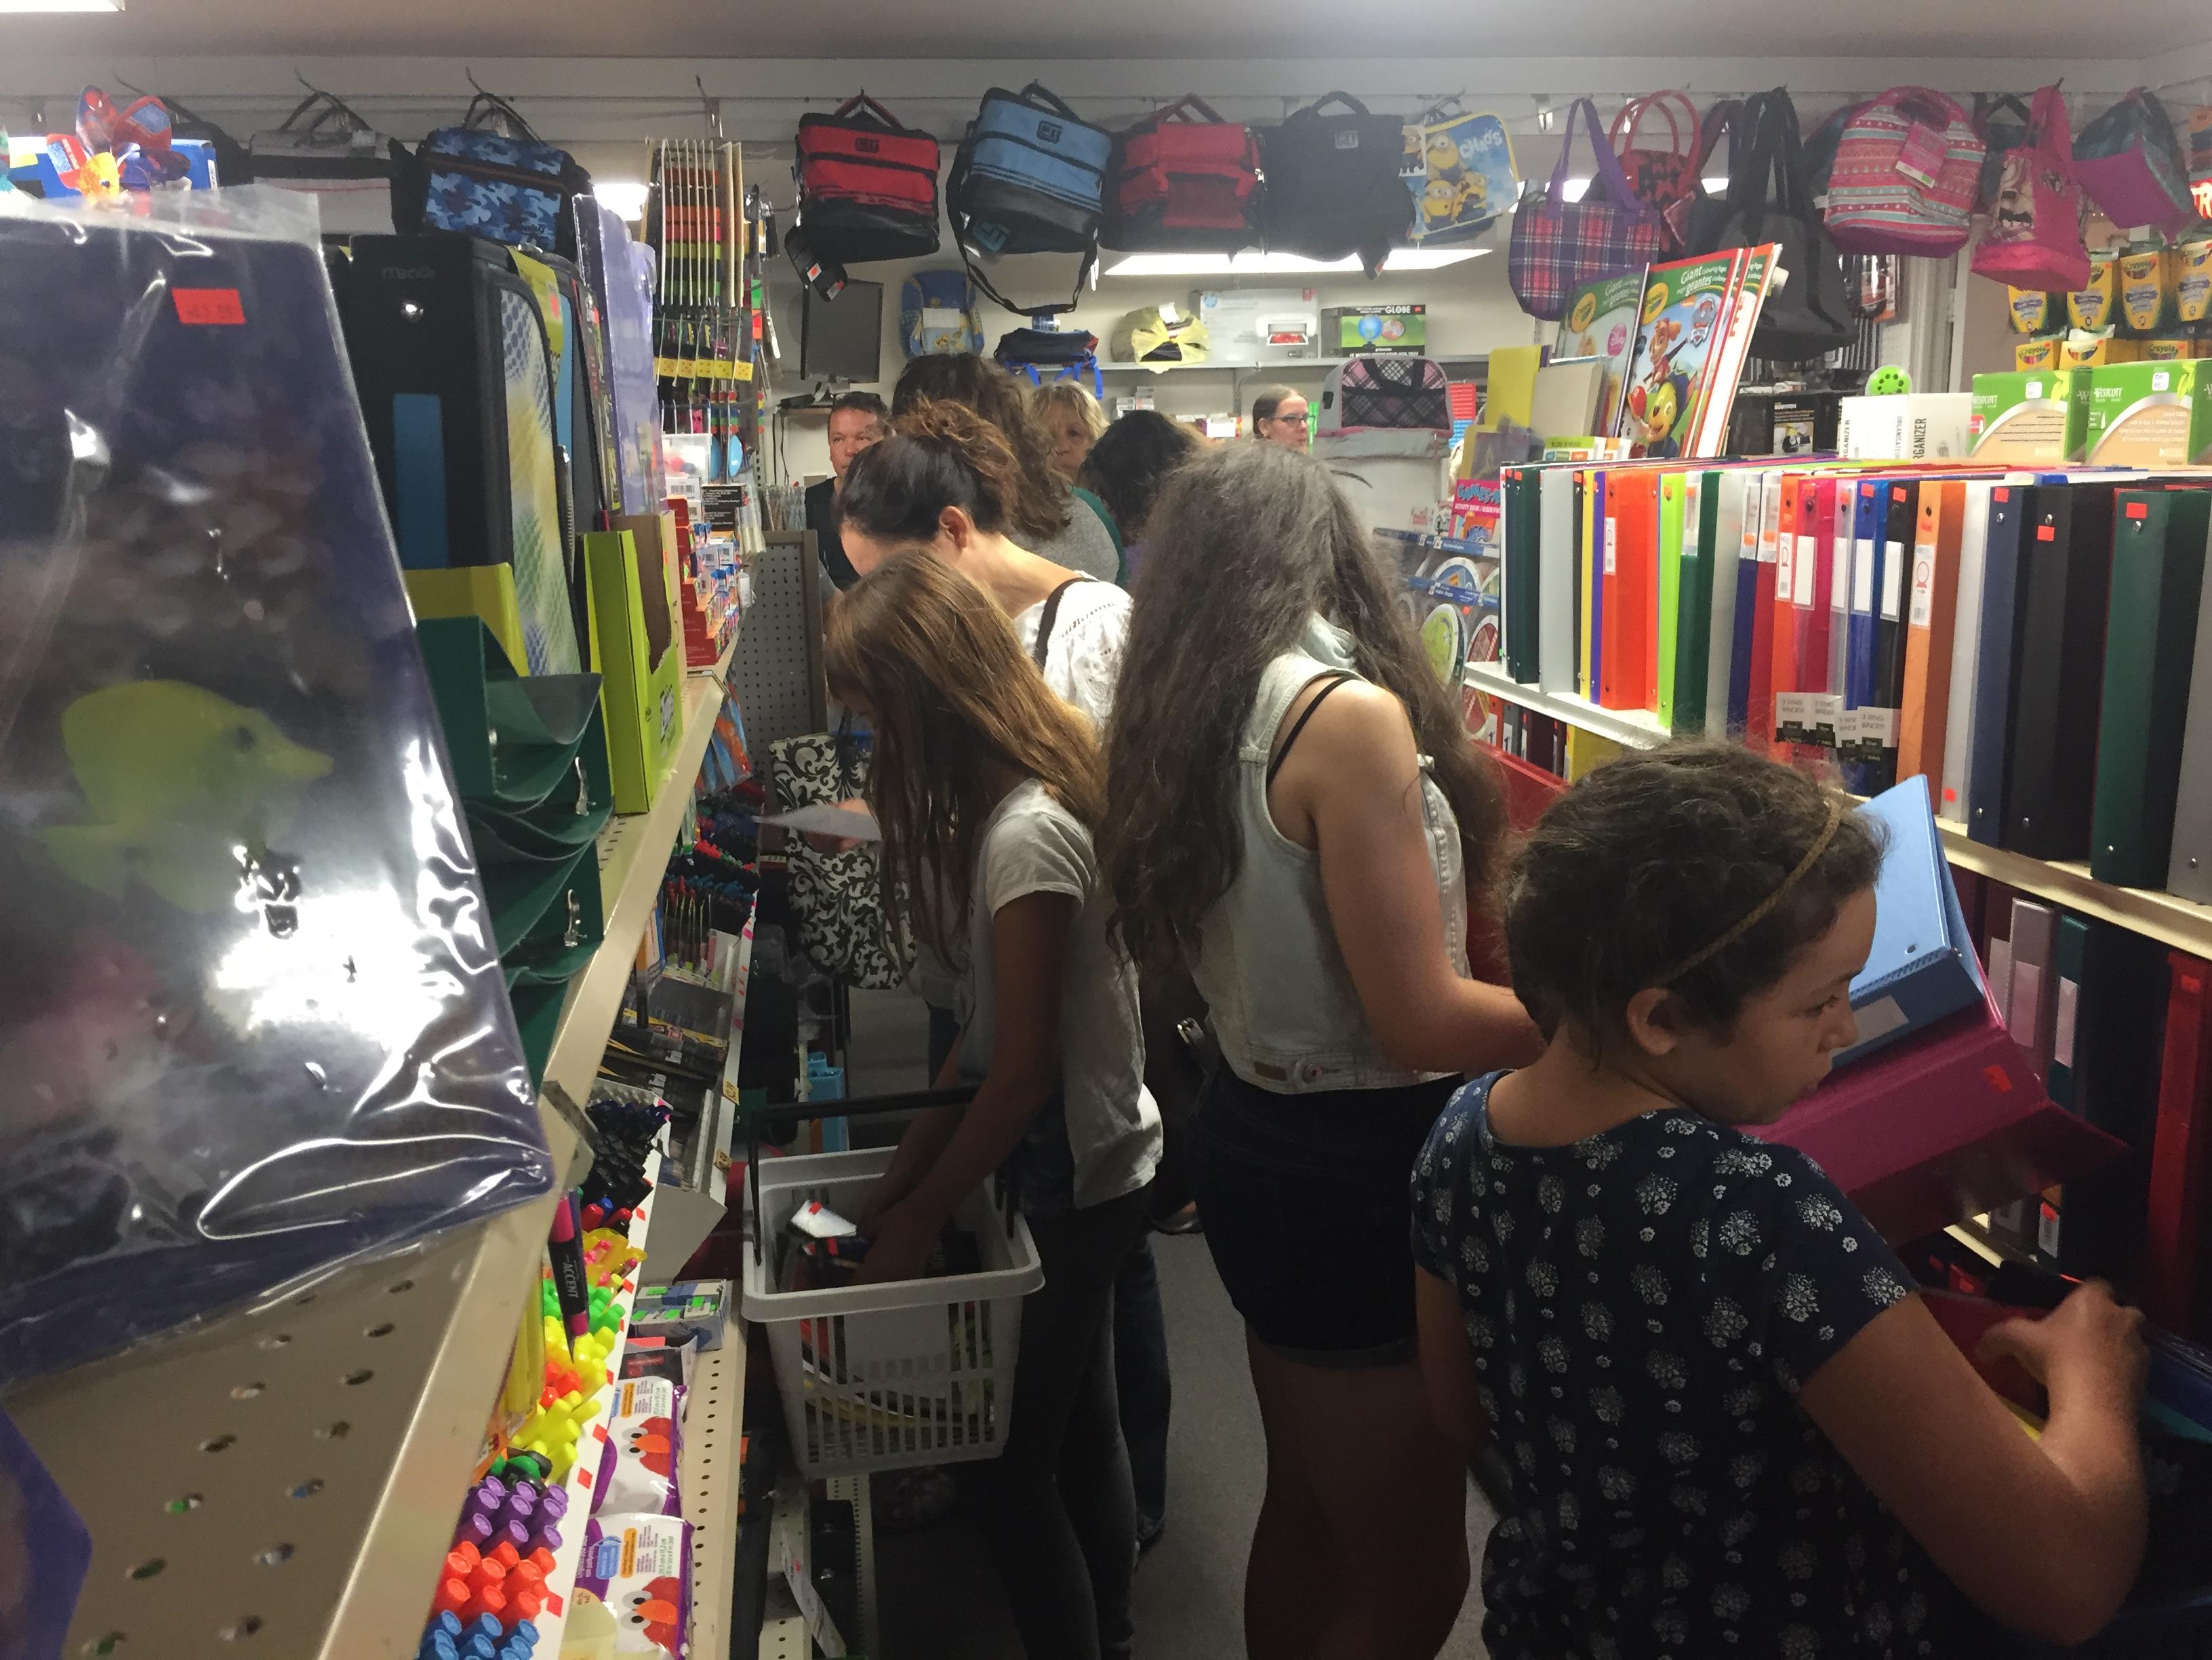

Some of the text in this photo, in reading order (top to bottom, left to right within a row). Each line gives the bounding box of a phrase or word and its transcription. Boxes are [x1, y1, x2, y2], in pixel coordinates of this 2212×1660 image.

[2094, 387, 2123, 398] WESTCOTT
[1913, 418, 1927, 459] RGANIZER
[563, 1261, 578, 1298] ACCENT
